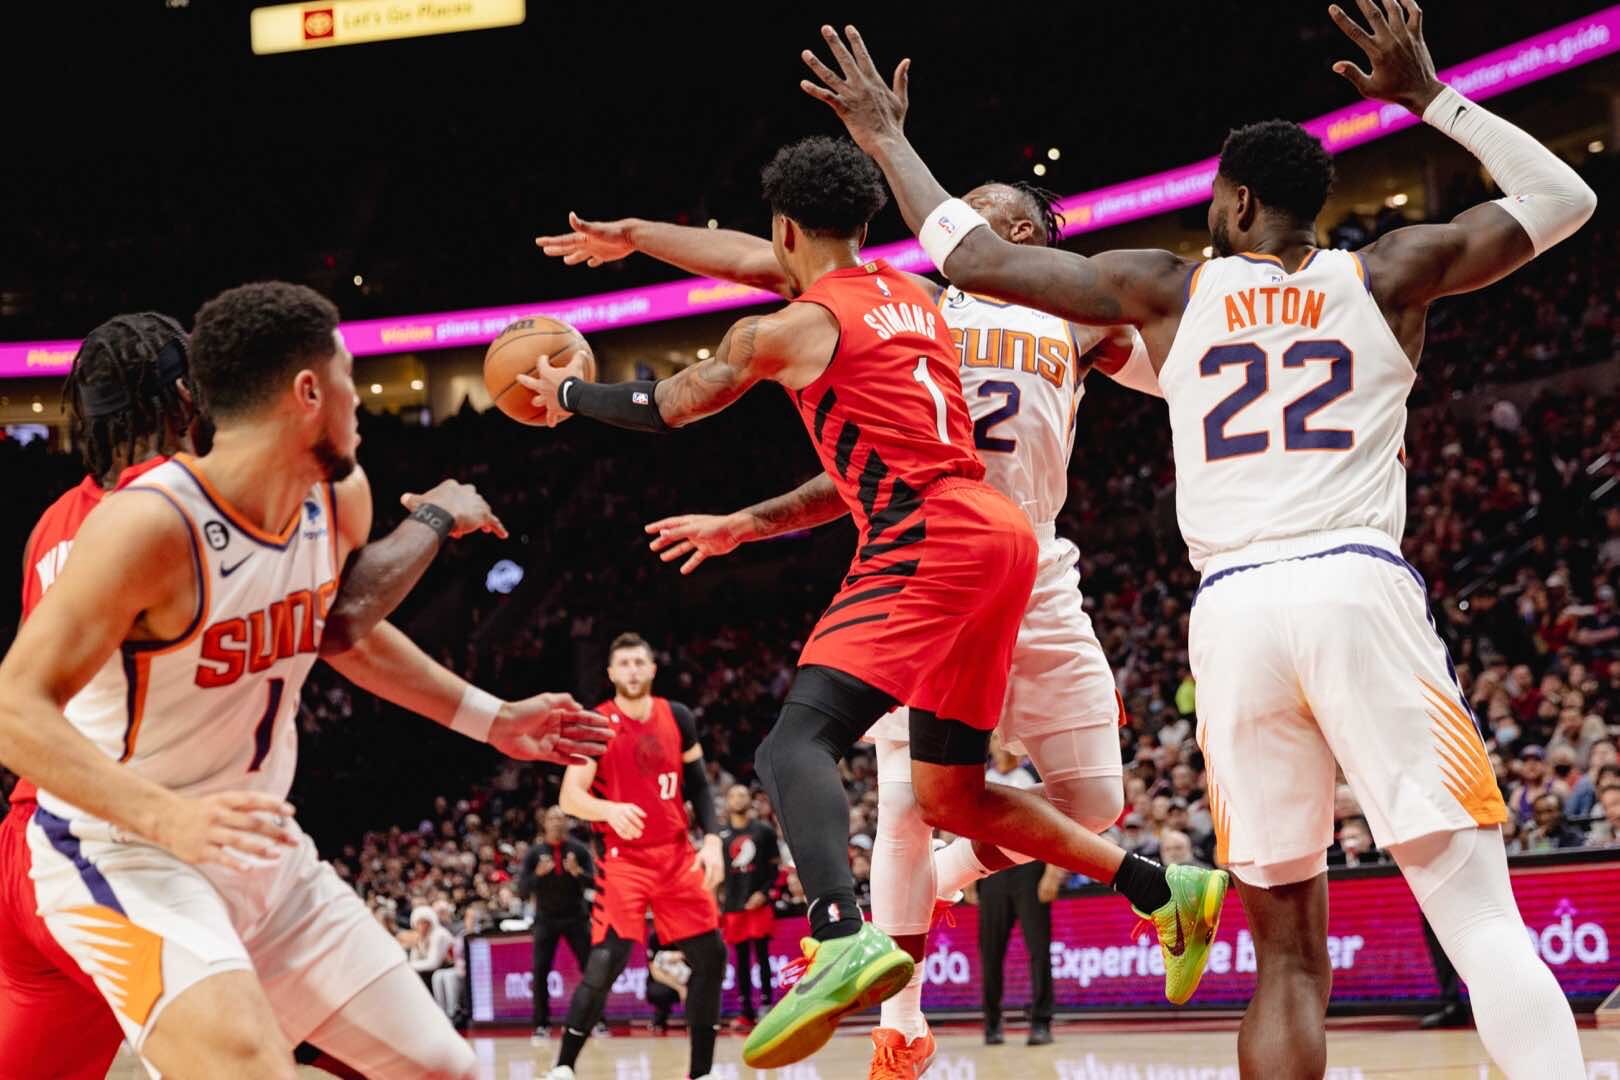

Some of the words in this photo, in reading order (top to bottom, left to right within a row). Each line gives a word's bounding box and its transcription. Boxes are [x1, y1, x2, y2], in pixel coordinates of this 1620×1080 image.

[863, 302, 937, 340] SIMONS
[1224, 287, 1326, 333] AYTON
[912, 354, 951, 446] 1
[973, 379, 1021, 453] 2
[1199, 339, 1355, 463] 22
[247, 677, 285, 774] 1
[657, 771, 679, 801] 27
[922, 944, 971, 985] da
[1050, 932, 1233, 988] Experiee
[1526, 912, 1609, 965] da
[505, 970, 565, 999] moa
